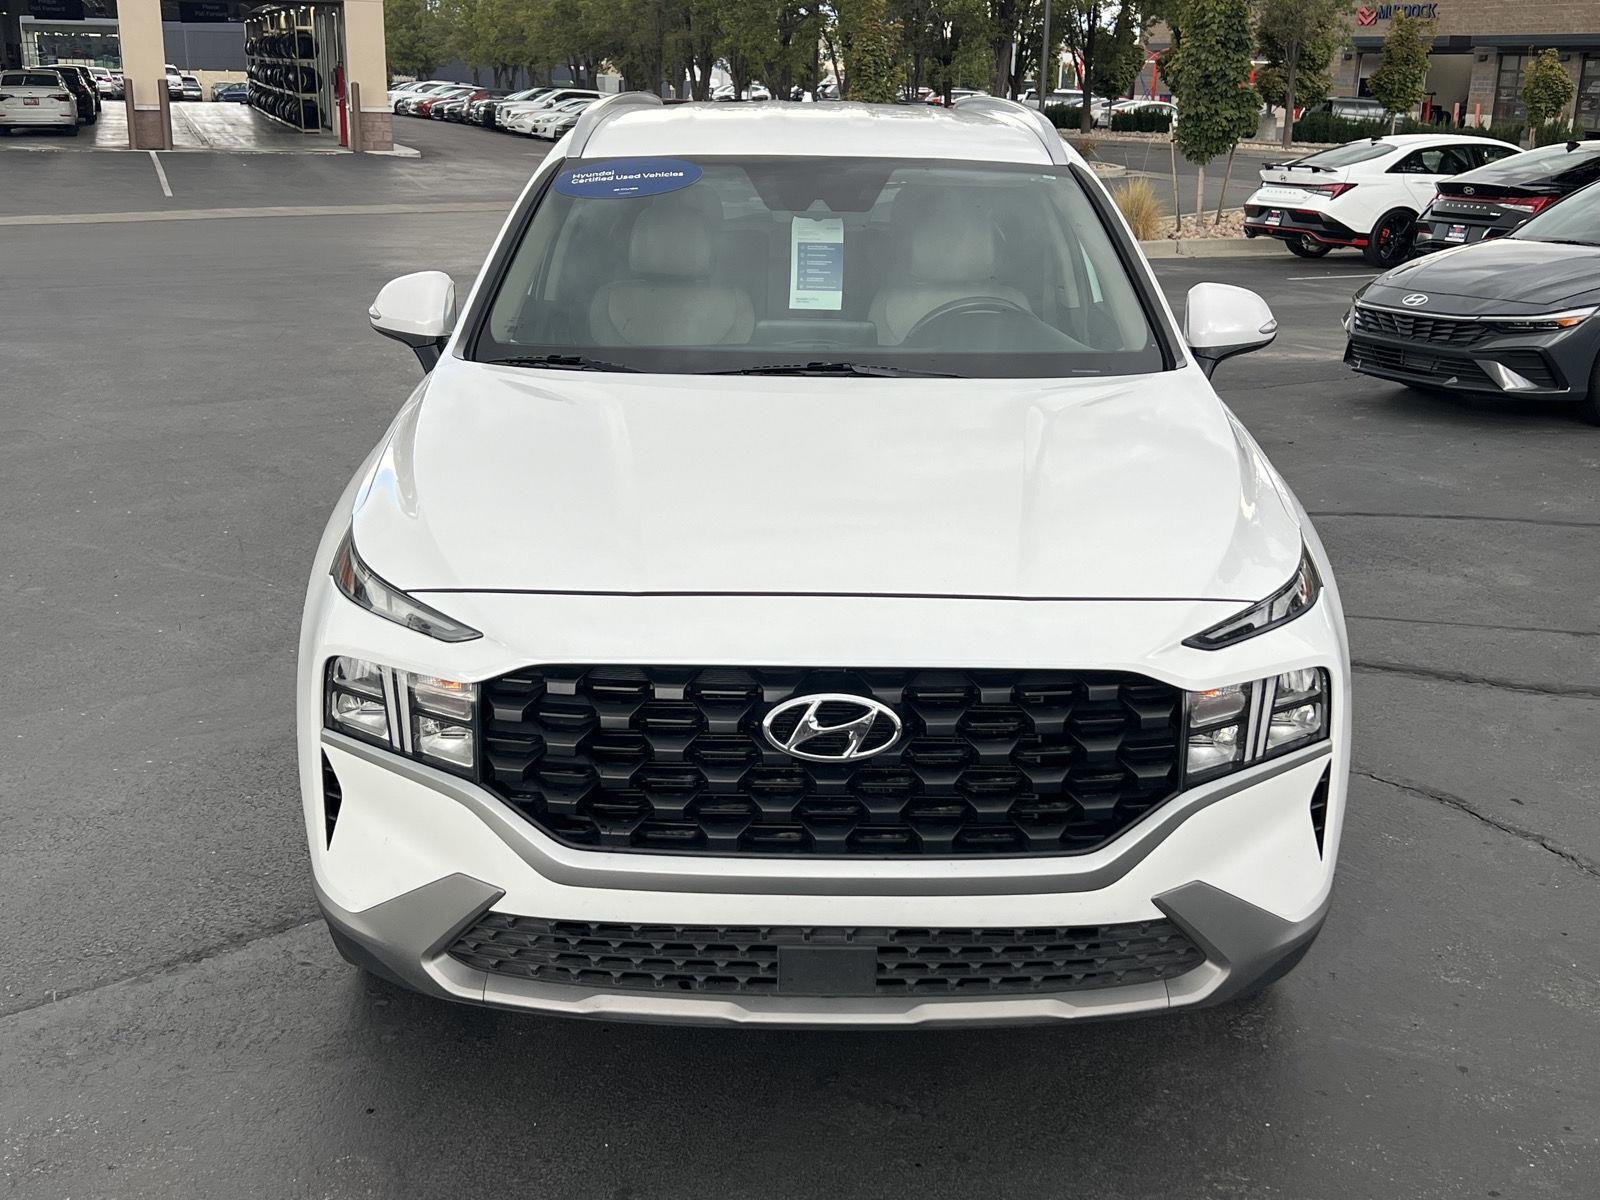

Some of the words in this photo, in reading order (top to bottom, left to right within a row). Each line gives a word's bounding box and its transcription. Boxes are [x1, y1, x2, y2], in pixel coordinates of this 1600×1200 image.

[571, 174, 614, 184] Certified
[615, 173, 641, 181] Used
[642, 171, 684, 179] Vehicles
[572, 170, 615, 179] Hyundai
